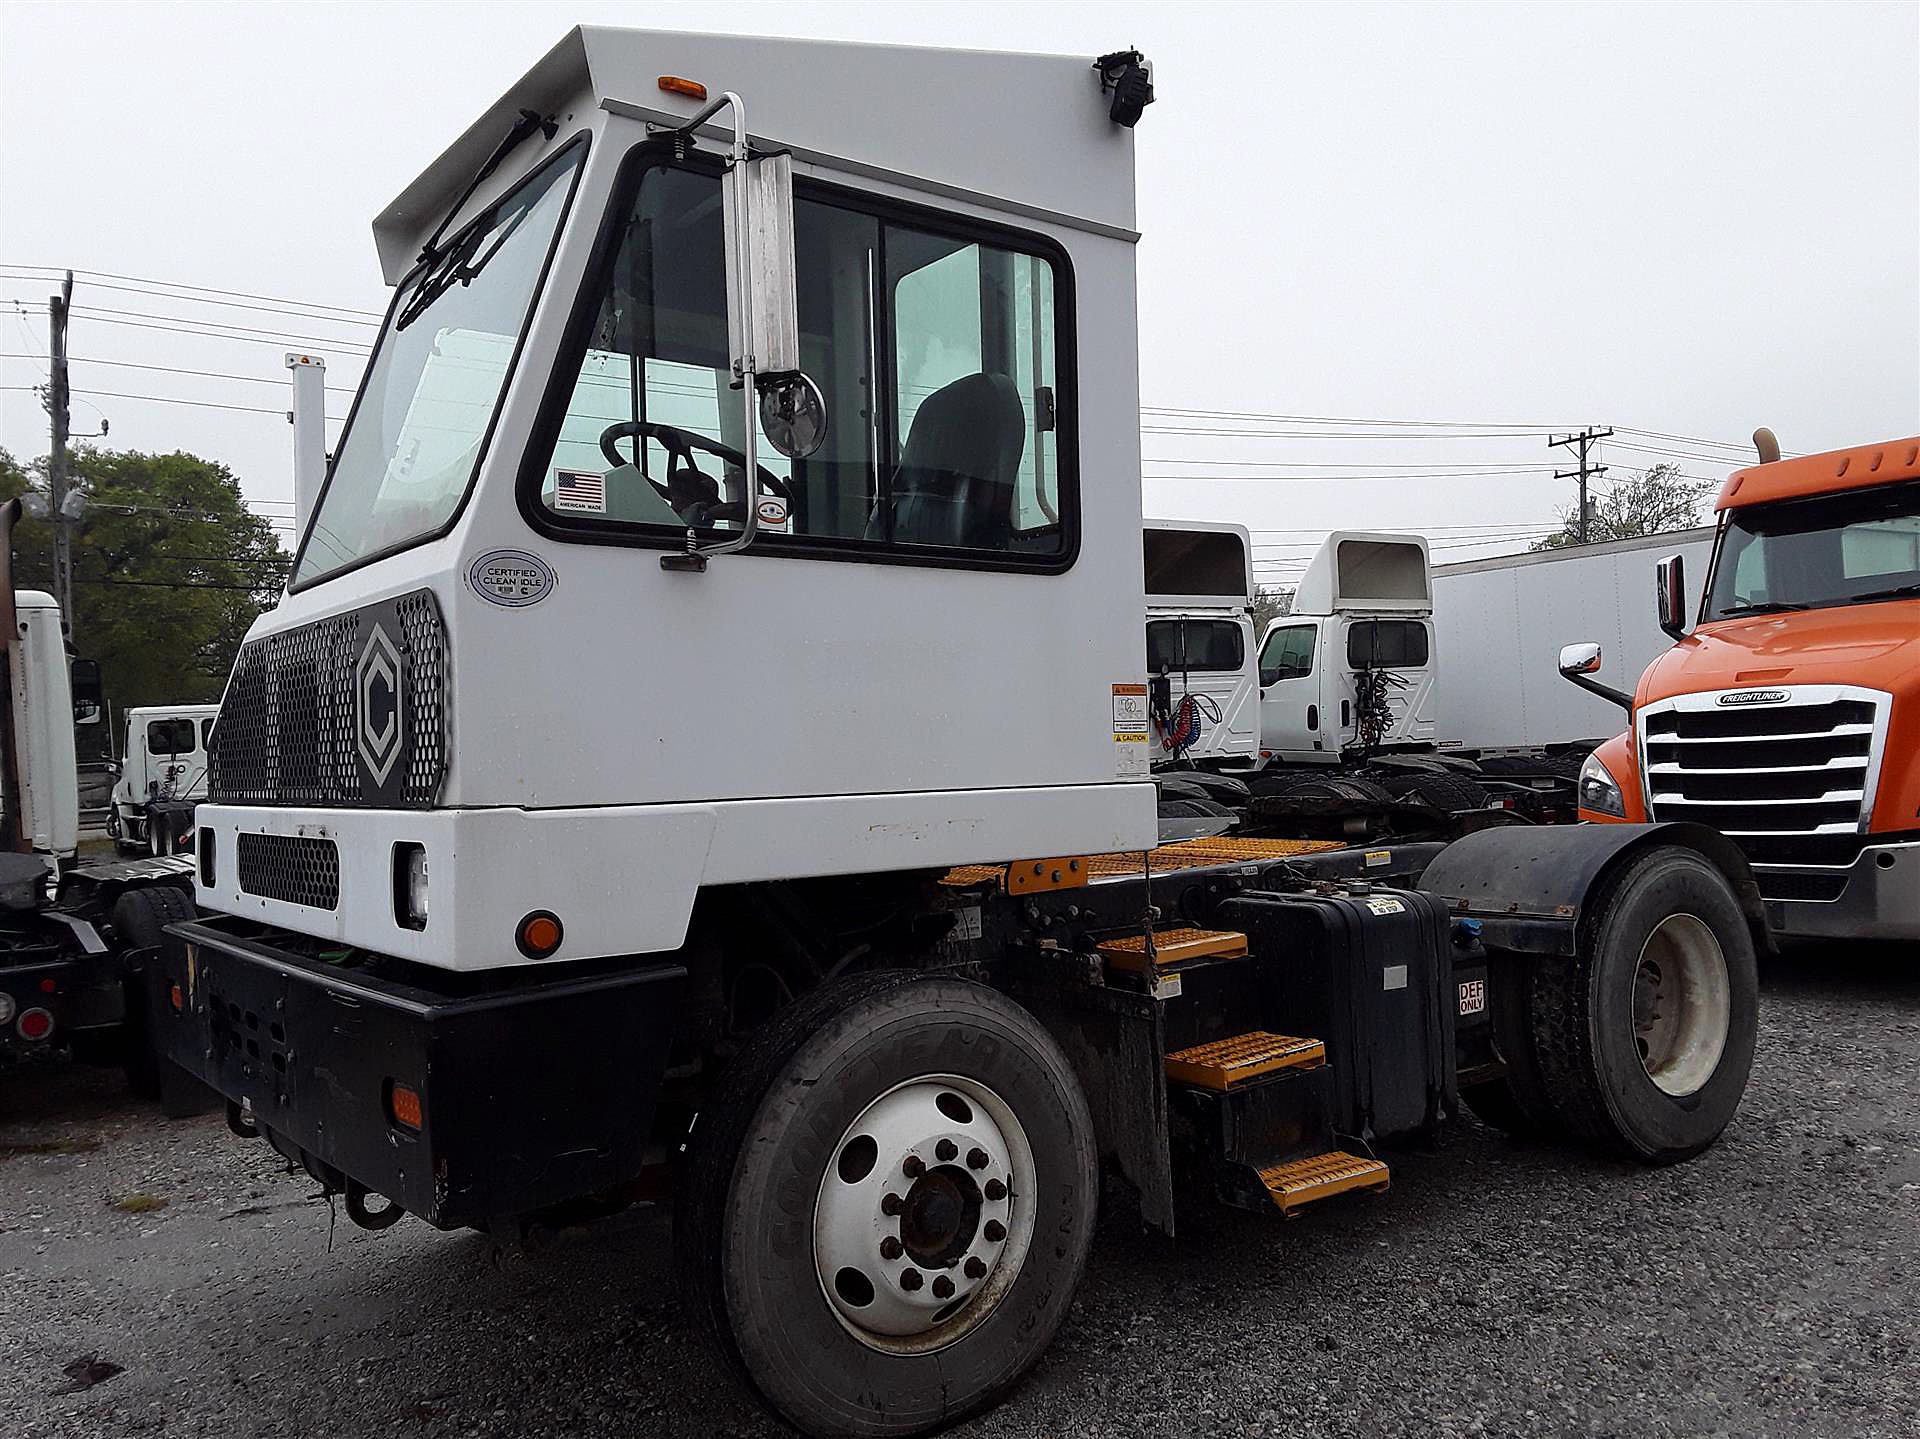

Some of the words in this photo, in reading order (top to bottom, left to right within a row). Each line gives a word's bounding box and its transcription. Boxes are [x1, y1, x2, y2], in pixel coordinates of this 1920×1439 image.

[487, 567, 537, 577] CERTIFIED
[483, 576, 516, 586] CLEAN
[520, 578, 542, 587] IDLE
[1722, 692, 1783, 703] FREIGHTLINER
[1460, 981, 1483, 1000] DEF
[1460, 998, 1483, 1013] ONLY
